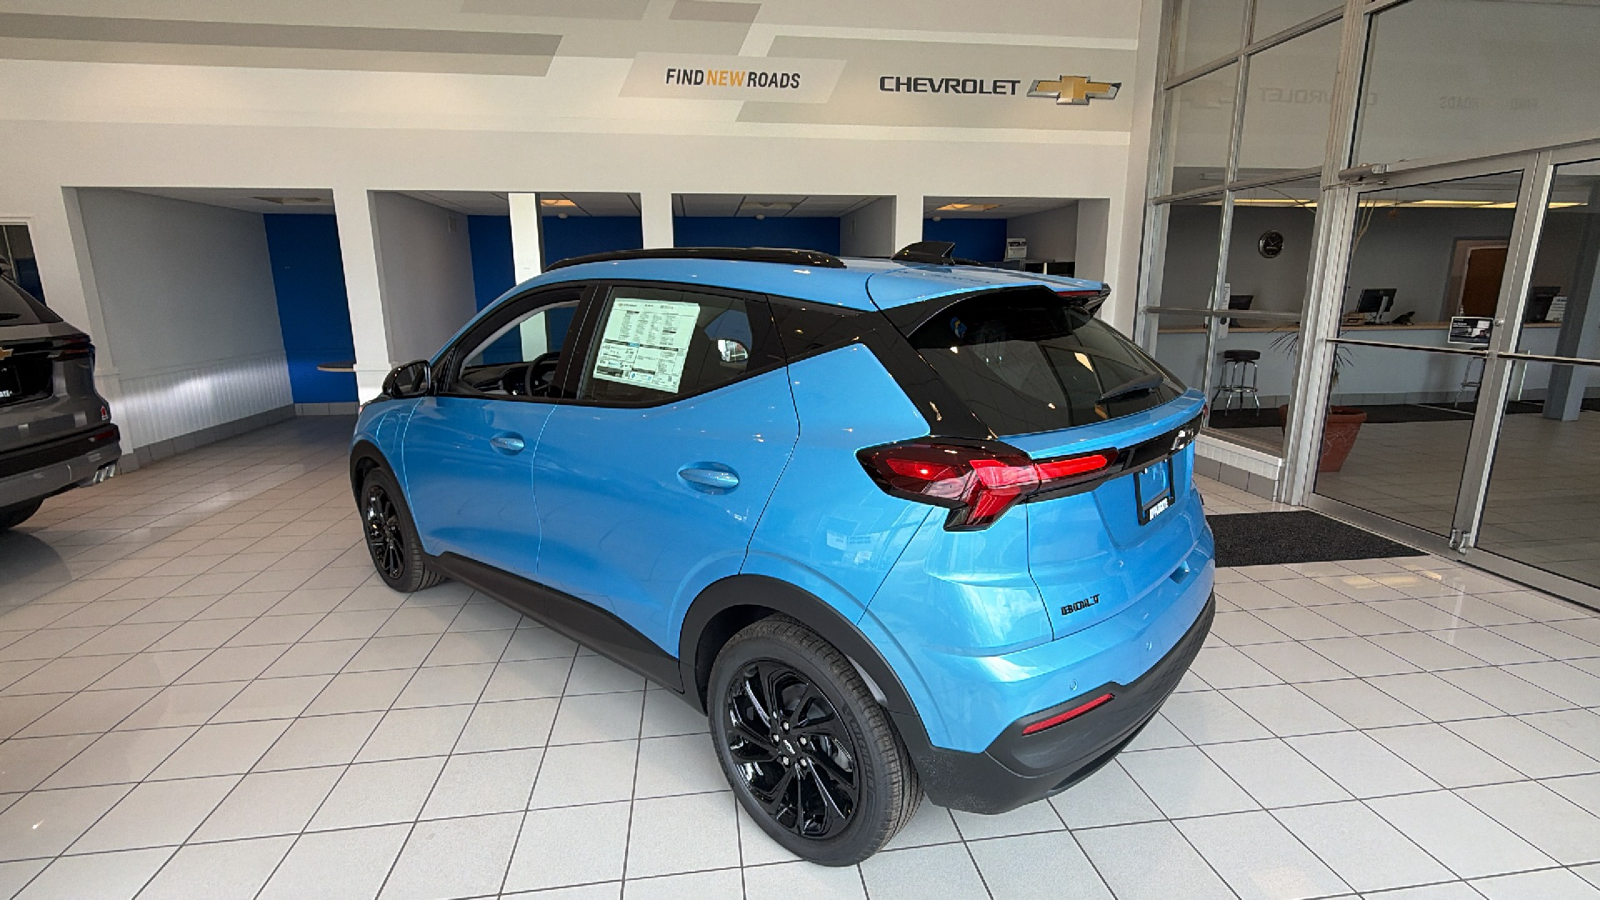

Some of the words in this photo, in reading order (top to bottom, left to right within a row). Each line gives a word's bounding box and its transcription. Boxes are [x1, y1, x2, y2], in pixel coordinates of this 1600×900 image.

[666, 69, 704, 85] FIND
[706, 70, 746, 87] NEW
[747, 71, 801, 89] ROADS
[880, 77, 1020, 95] CHEVROLET
[1061, 593, 1100, 615] BOLT
